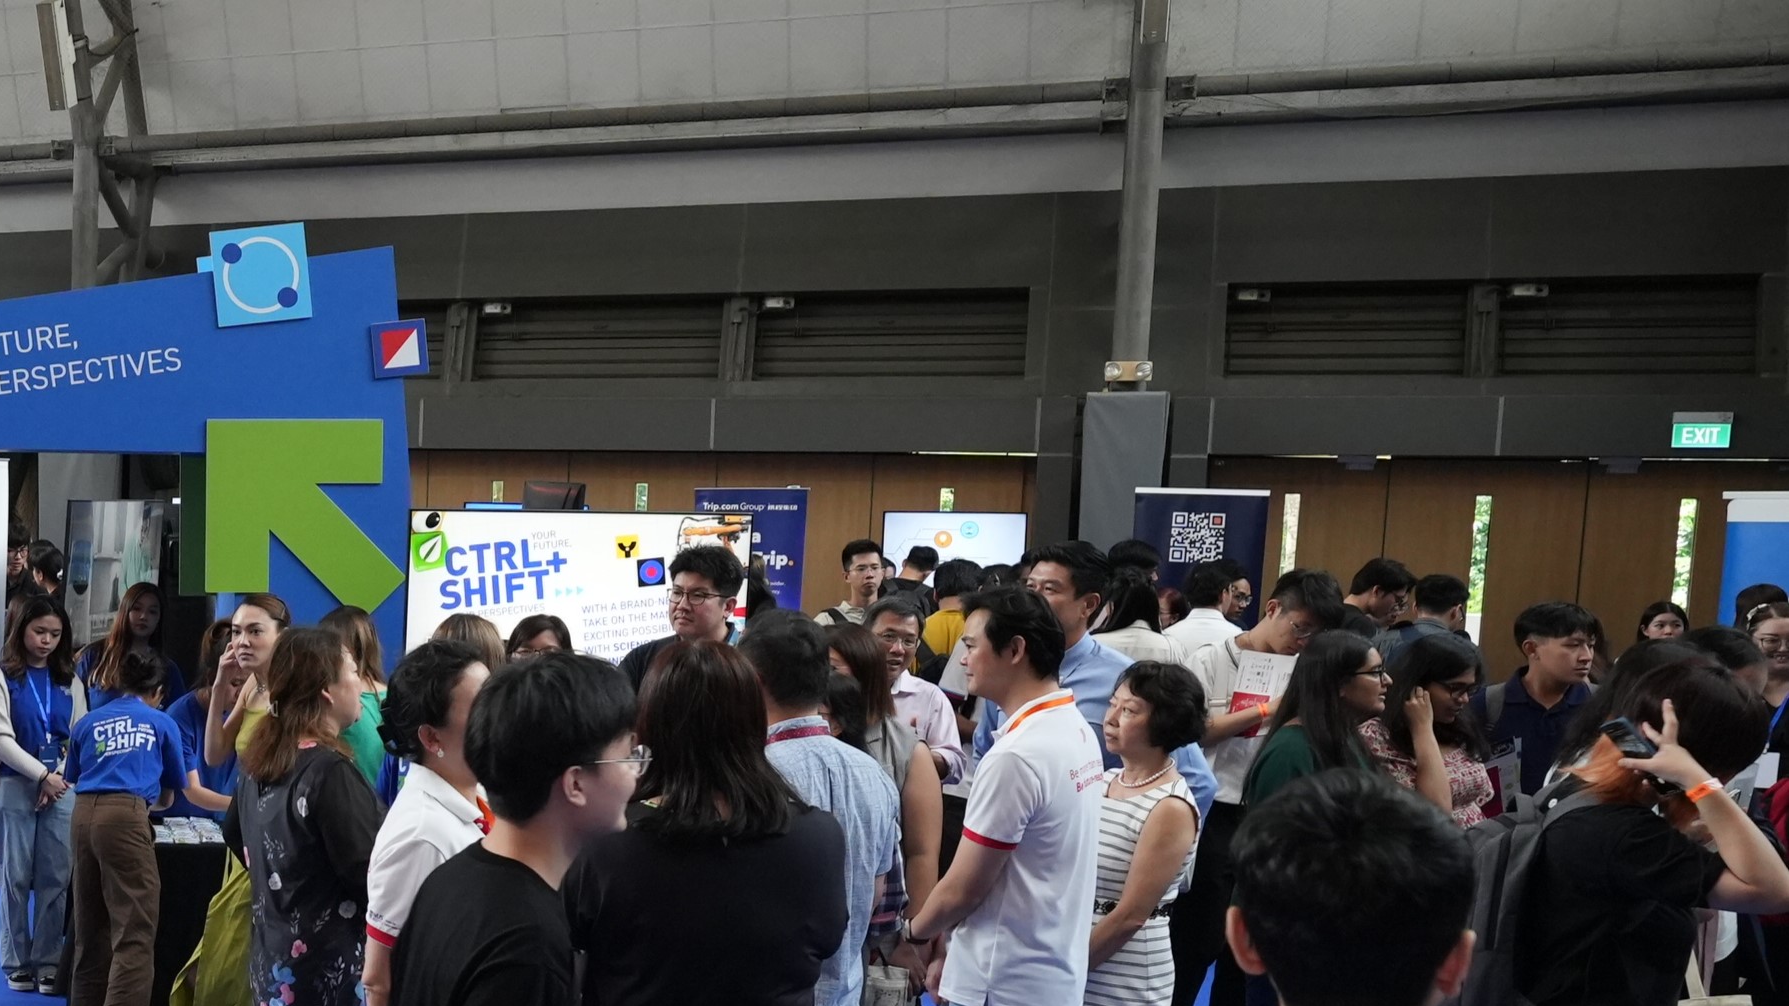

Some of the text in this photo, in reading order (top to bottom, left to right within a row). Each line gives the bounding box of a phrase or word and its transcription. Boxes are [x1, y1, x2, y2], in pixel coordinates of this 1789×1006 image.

[1681, 427, 1721, 444] EXIT
[703, 502, 739, 511] Trip.com
[739, 502, 765, 512] Group
[531, 530, 557, 540] YOUR
[439, 569, 550, 610] SHIFT
[478, 603, 546, 618] PERSPECTIVES
[581, 597, 670, 614] WITH A BRAND-NE
[582, 610, 669, 628] TAKE ON THE MAN
[584, 623, 672, 641] EXCITING POSSIBI
[585, 644, 611, 655] WITH
[94, 719, 138, 741] CTRL
[106, 732, 156, 752] SHIFT
